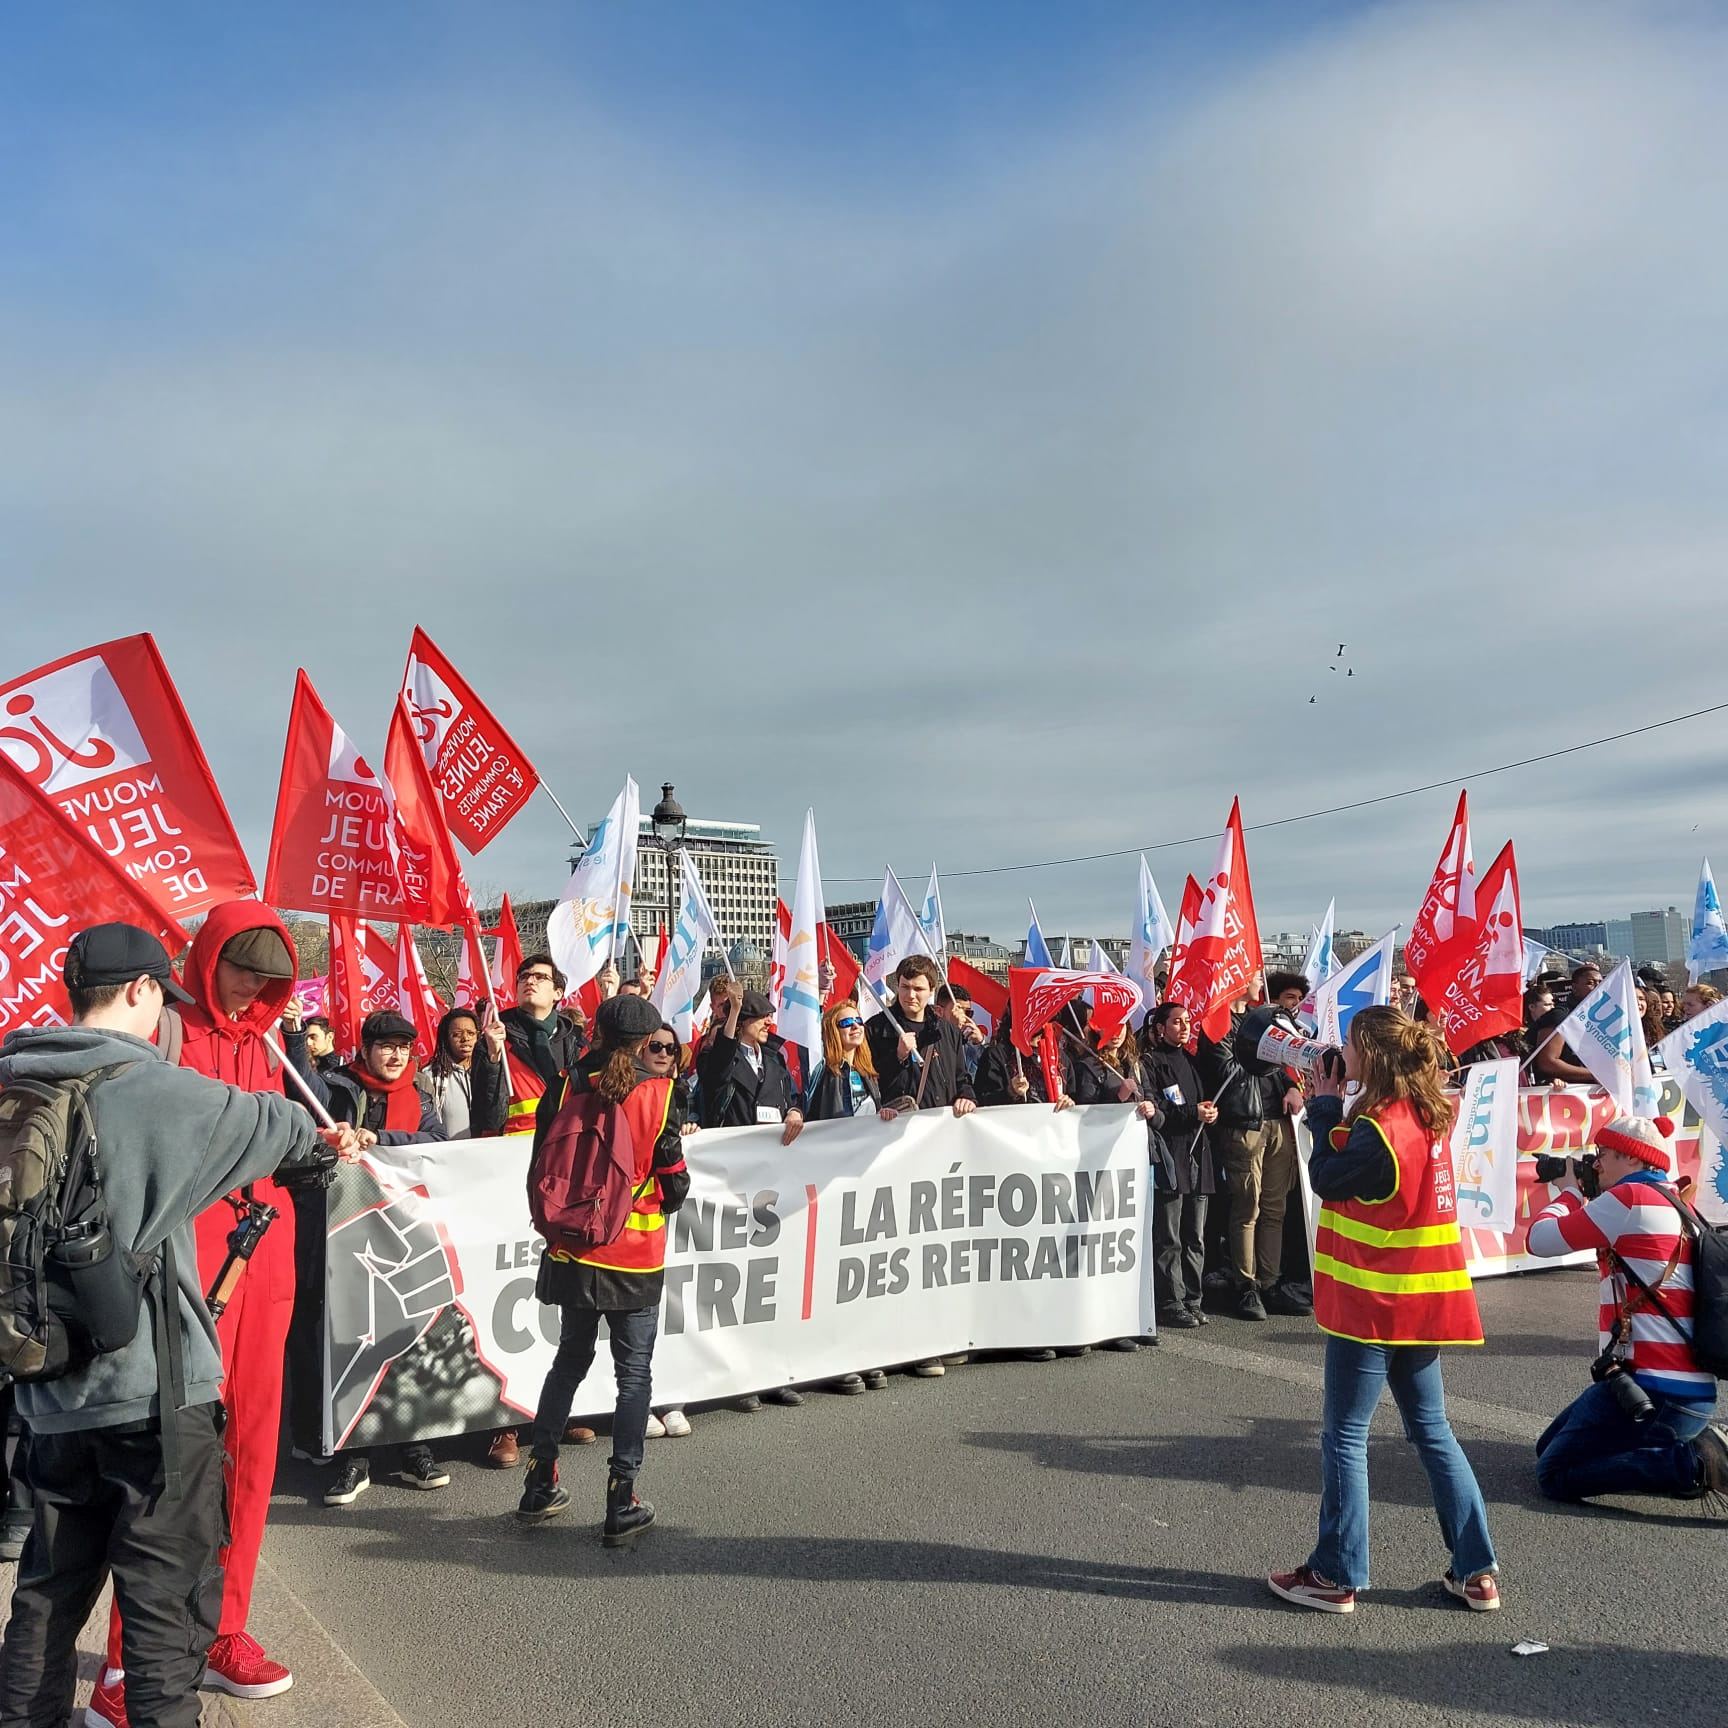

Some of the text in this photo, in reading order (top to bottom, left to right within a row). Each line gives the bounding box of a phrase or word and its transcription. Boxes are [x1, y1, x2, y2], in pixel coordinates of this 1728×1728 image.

[310, 874, 348, 900] DE
[1464, 1085, 1481, 1135] syndicat
[839, 1161, 1137, 1247] LA RÉFORME
[495, 1239, 546, 1271] LES
[836, 1228, 1137, 1305] DES RETRAITES
